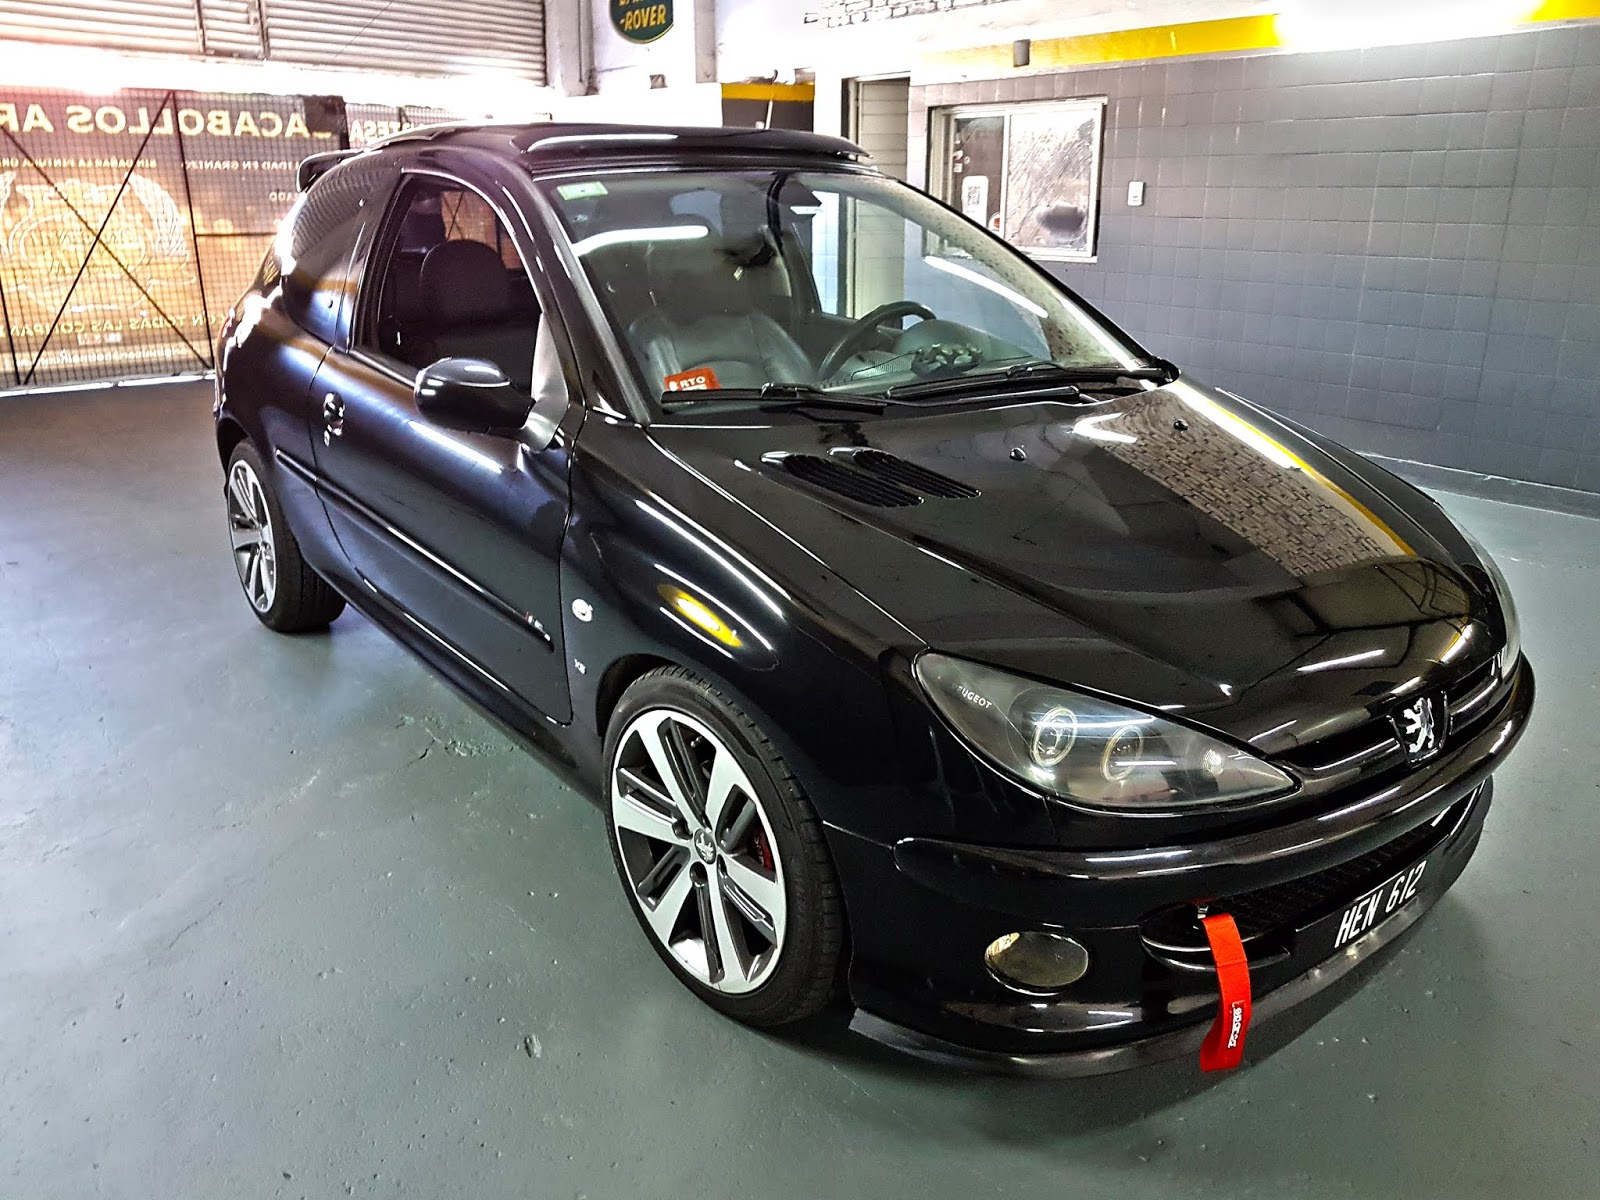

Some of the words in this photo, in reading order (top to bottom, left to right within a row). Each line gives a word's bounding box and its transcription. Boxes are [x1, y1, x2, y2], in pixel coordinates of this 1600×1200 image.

[680, 376, 706, 388] RTO
[952, 683, 993, 709] PEUGEOT
[1334, 889, 1384, 949] HEN
[1385, 860, 1427, 913] 612
